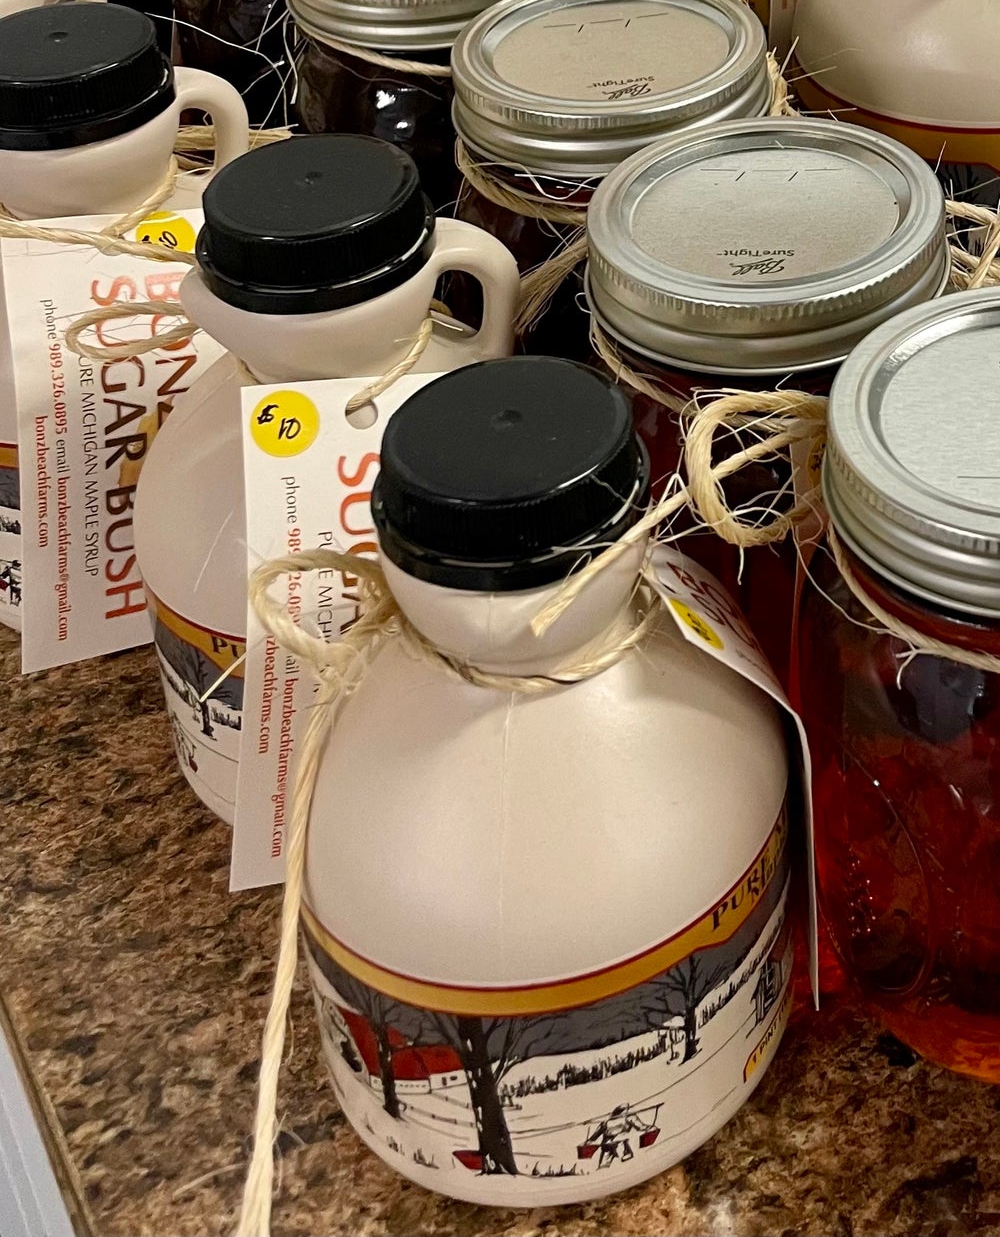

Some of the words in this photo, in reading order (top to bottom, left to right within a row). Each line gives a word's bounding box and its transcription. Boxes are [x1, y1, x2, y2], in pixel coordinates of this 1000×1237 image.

[588, 75, 656, 89] SureTight
[602, 82, 652, 100] Ball
[719, 248, 796, 258] SureTight
[728, 257, 786, 276] Ball
[40, 298, 57, 340] phone
[49, 342, 68, 435] 989.326.0895
[77, 354, 94, 387] URE
[91, 276, 149, 471] SUGAR
[54, 439, 71, 474] email
[81, 392, 99, 476] MICHIGAN
[34, 415, 52, 548] bonzbeachfarms.com
[83, 480, 99, 530] MAPLE
[280, 475, 301, 525] phone
[54, 475, 73, 642] bonzbeachfarms@gmail.com
[84, 532, 100, 578] SYRUP
[104, 484, 149, 620] BUSH
[258, 633, 279, 755] zbeachfarms.com
[270, 677, 300, 859] bonzbeachfarms@gmail.com
